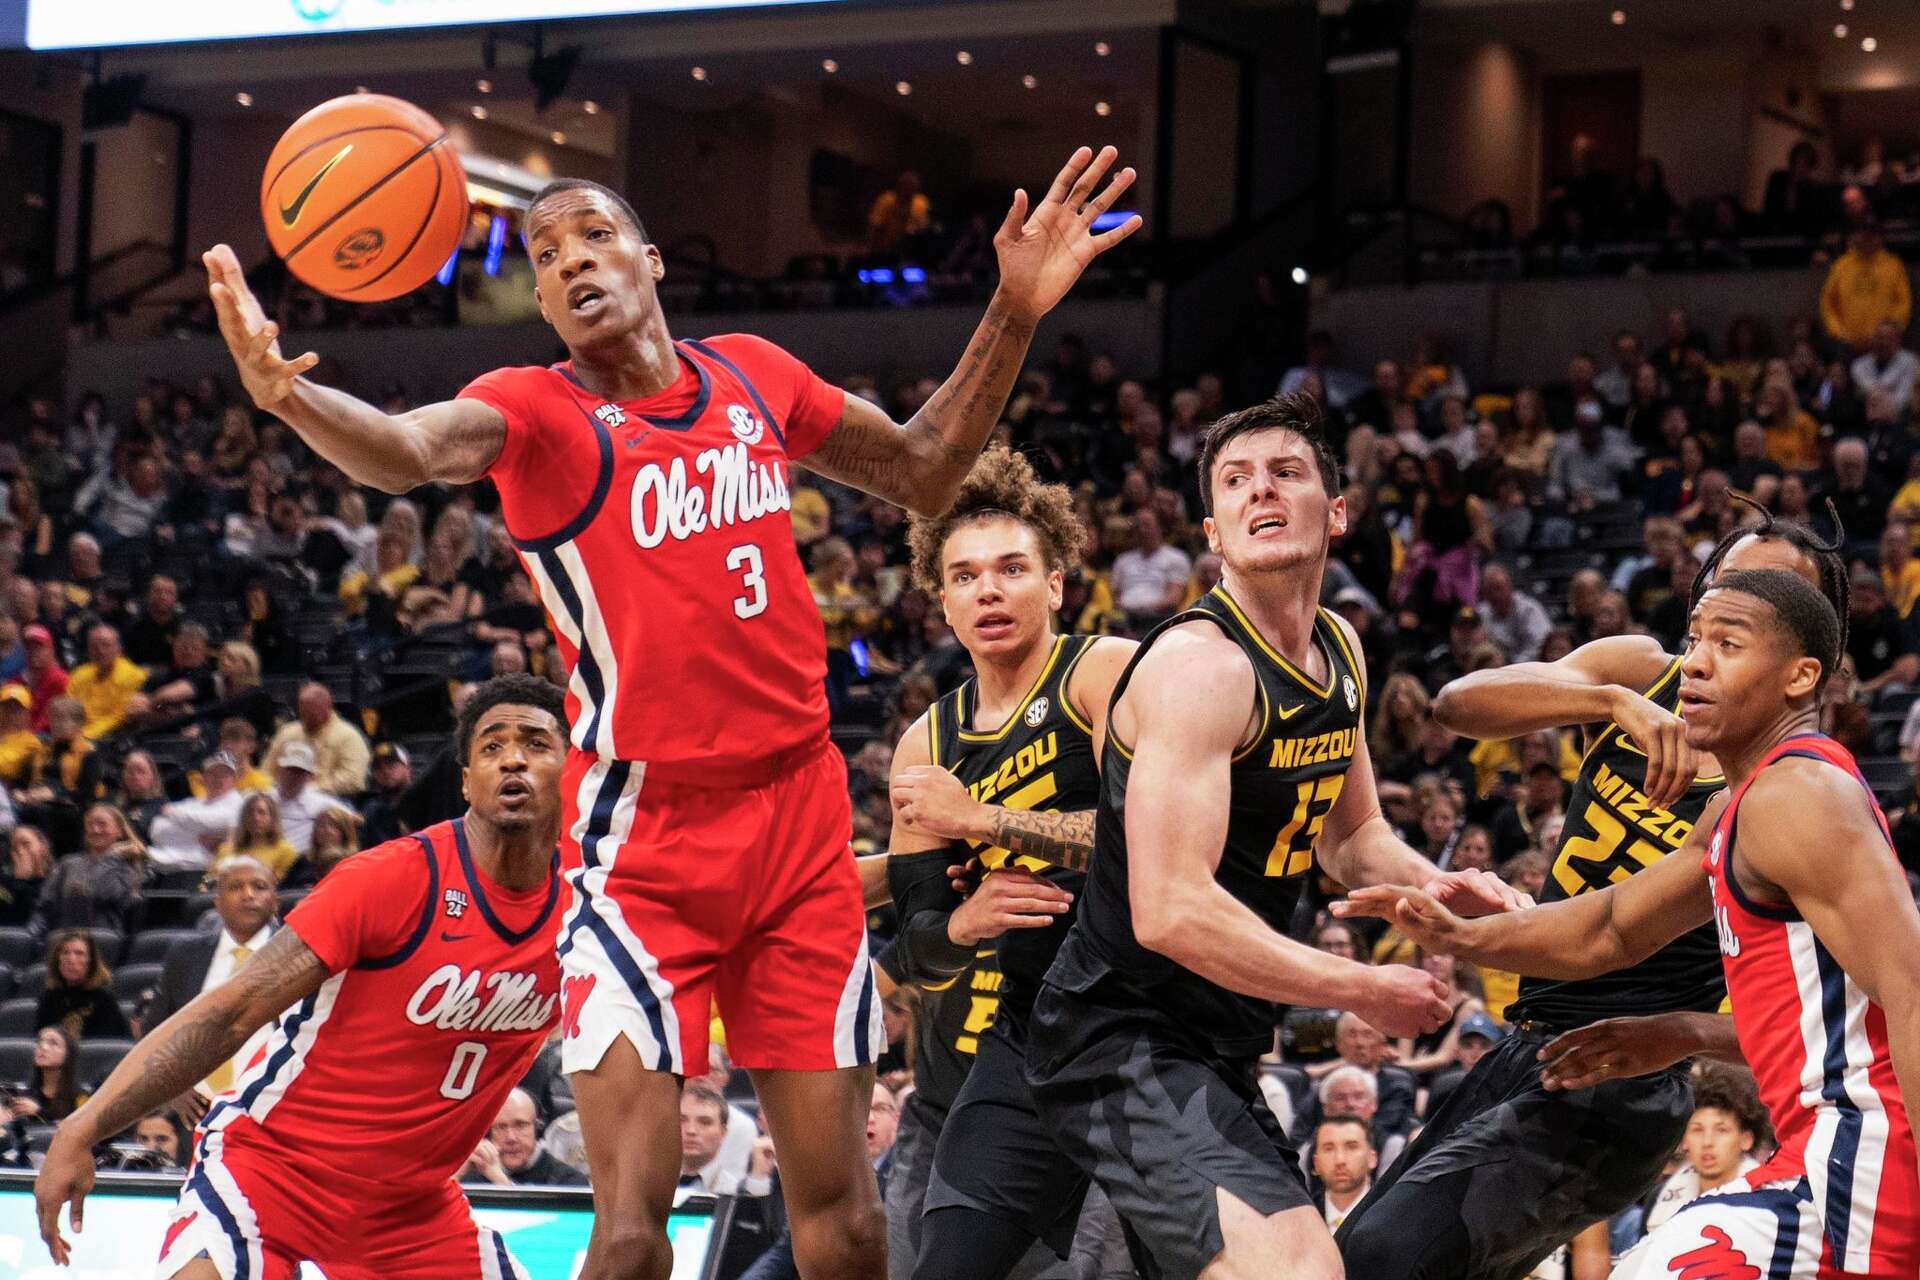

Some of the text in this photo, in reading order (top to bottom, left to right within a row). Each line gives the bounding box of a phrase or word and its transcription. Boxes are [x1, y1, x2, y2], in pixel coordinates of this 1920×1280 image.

[631, 456, 708, 549] Ole
[696, 441, 791, 529] Miss
[725, 544, 768, 619] 3
[1025, 697, 1049, 727] SEC
[967, 731, 1057, 804] IZZOU
[1269, 727, 1357, 768] MIZZOU
[1264, 774, 1344, 877] 13
[1592, 762, 1695, 850] MIZZO
[445, 889, 468, 907] BALL
[406, 965, 558, 1032] Ole Miss
[440, 1041, 488, 1100] 0
